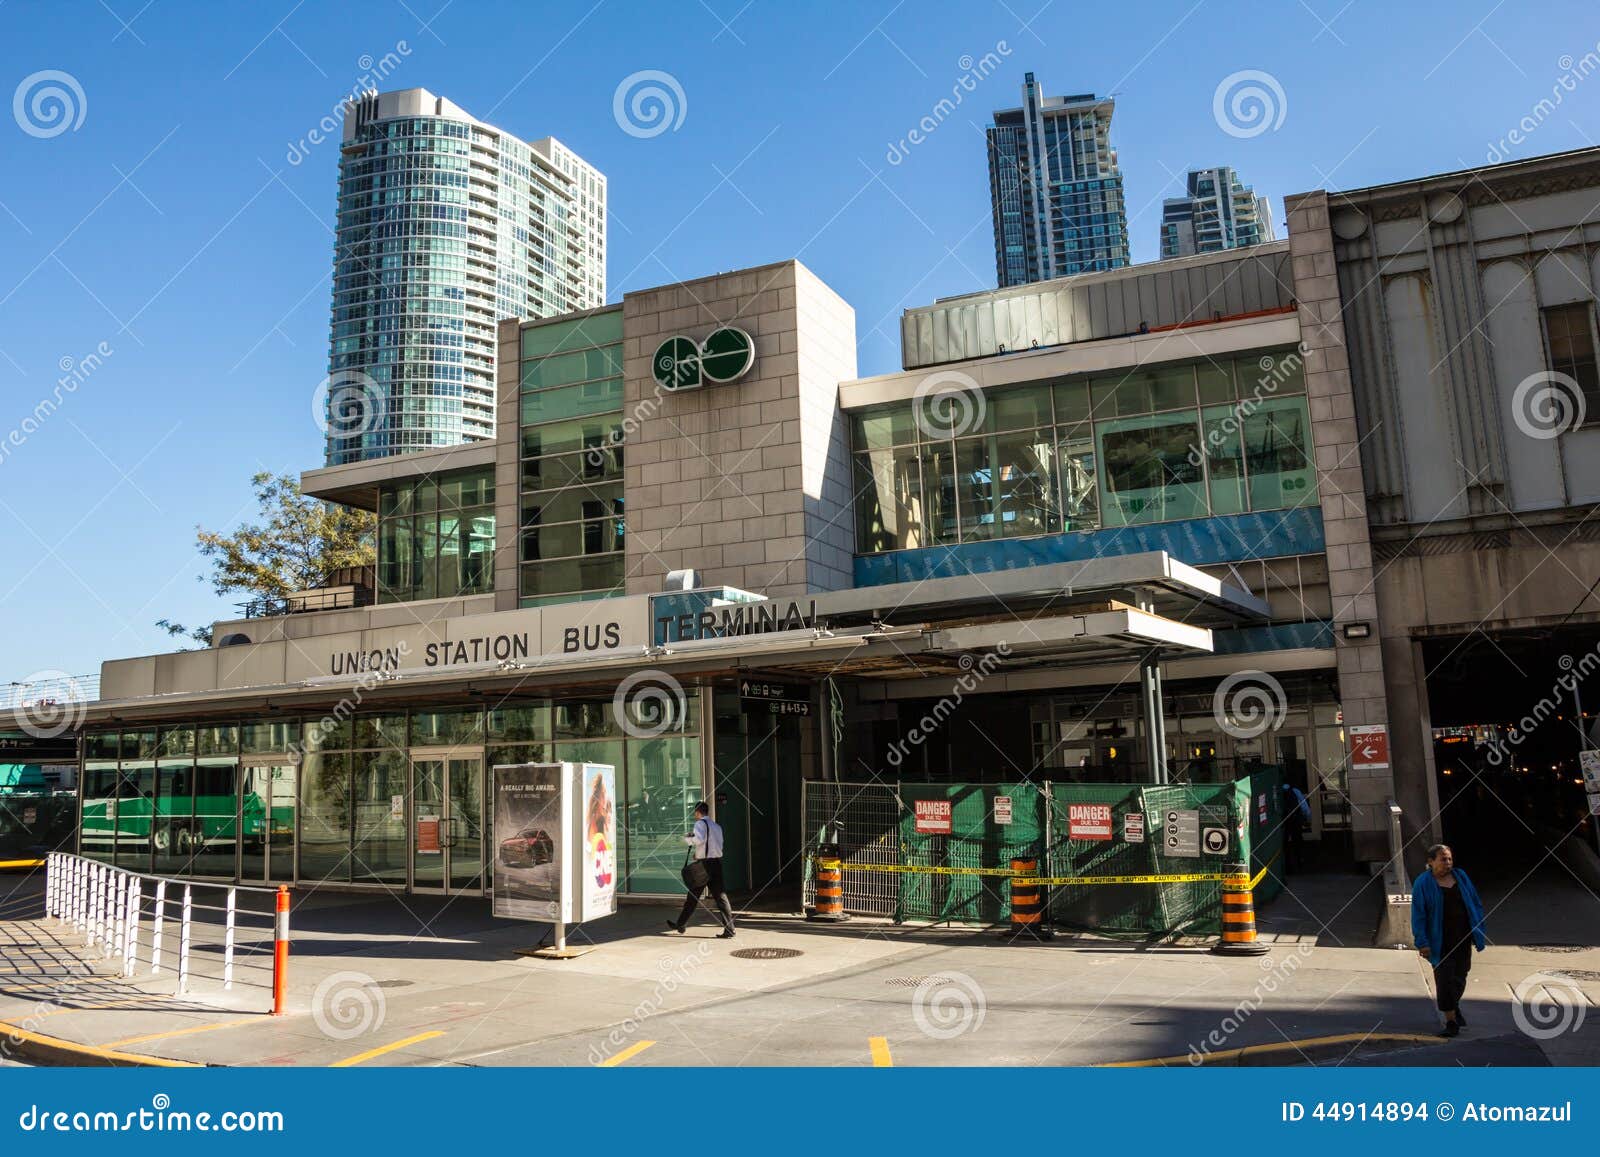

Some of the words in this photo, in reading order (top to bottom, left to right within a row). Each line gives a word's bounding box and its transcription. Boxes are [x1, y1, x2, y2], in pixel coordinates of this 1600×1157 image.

[331, 648, 399, 676] UNION
[424, 632, 529, 667] STATION
[563, 622, 620, 653] BUS
[657, 600, 829, 644] TERMINAL
[916, 801, 950, 815] DANGER
[1070, 806, 1110, 821] DANGER
